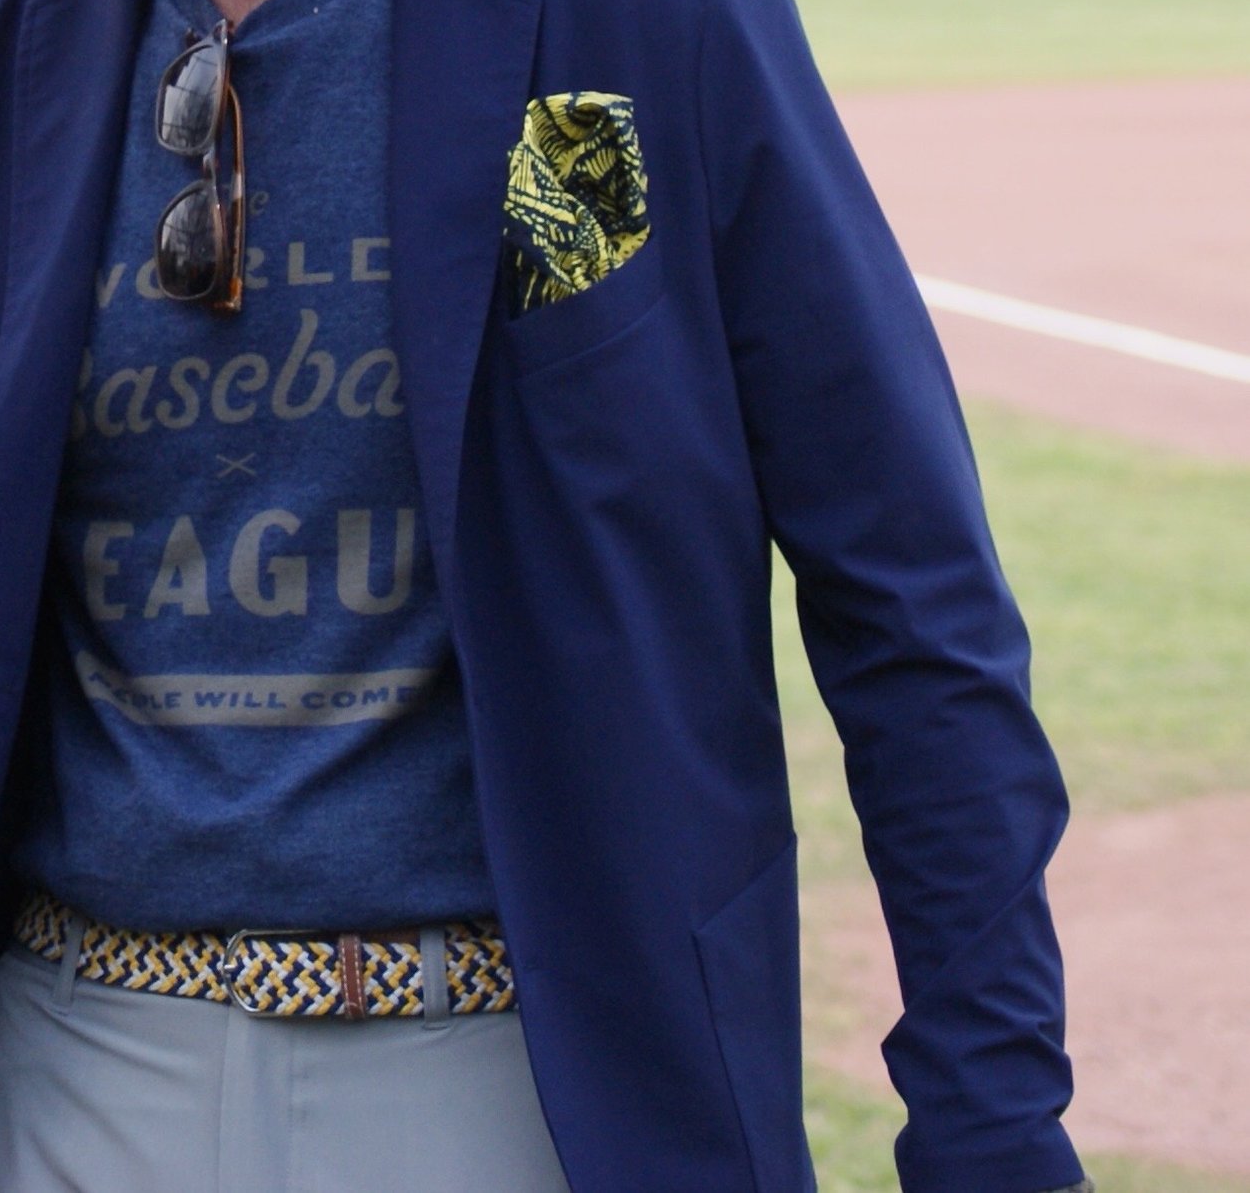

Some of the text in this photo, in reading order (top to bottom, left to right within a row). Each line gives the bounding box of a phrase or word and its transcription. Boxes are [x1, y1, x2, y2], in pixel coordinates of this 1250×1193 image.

[72, 308, 406, 439] aseba
[82, 508, 415, 622] EAGU
[194, 691, 286, 708] WILL
